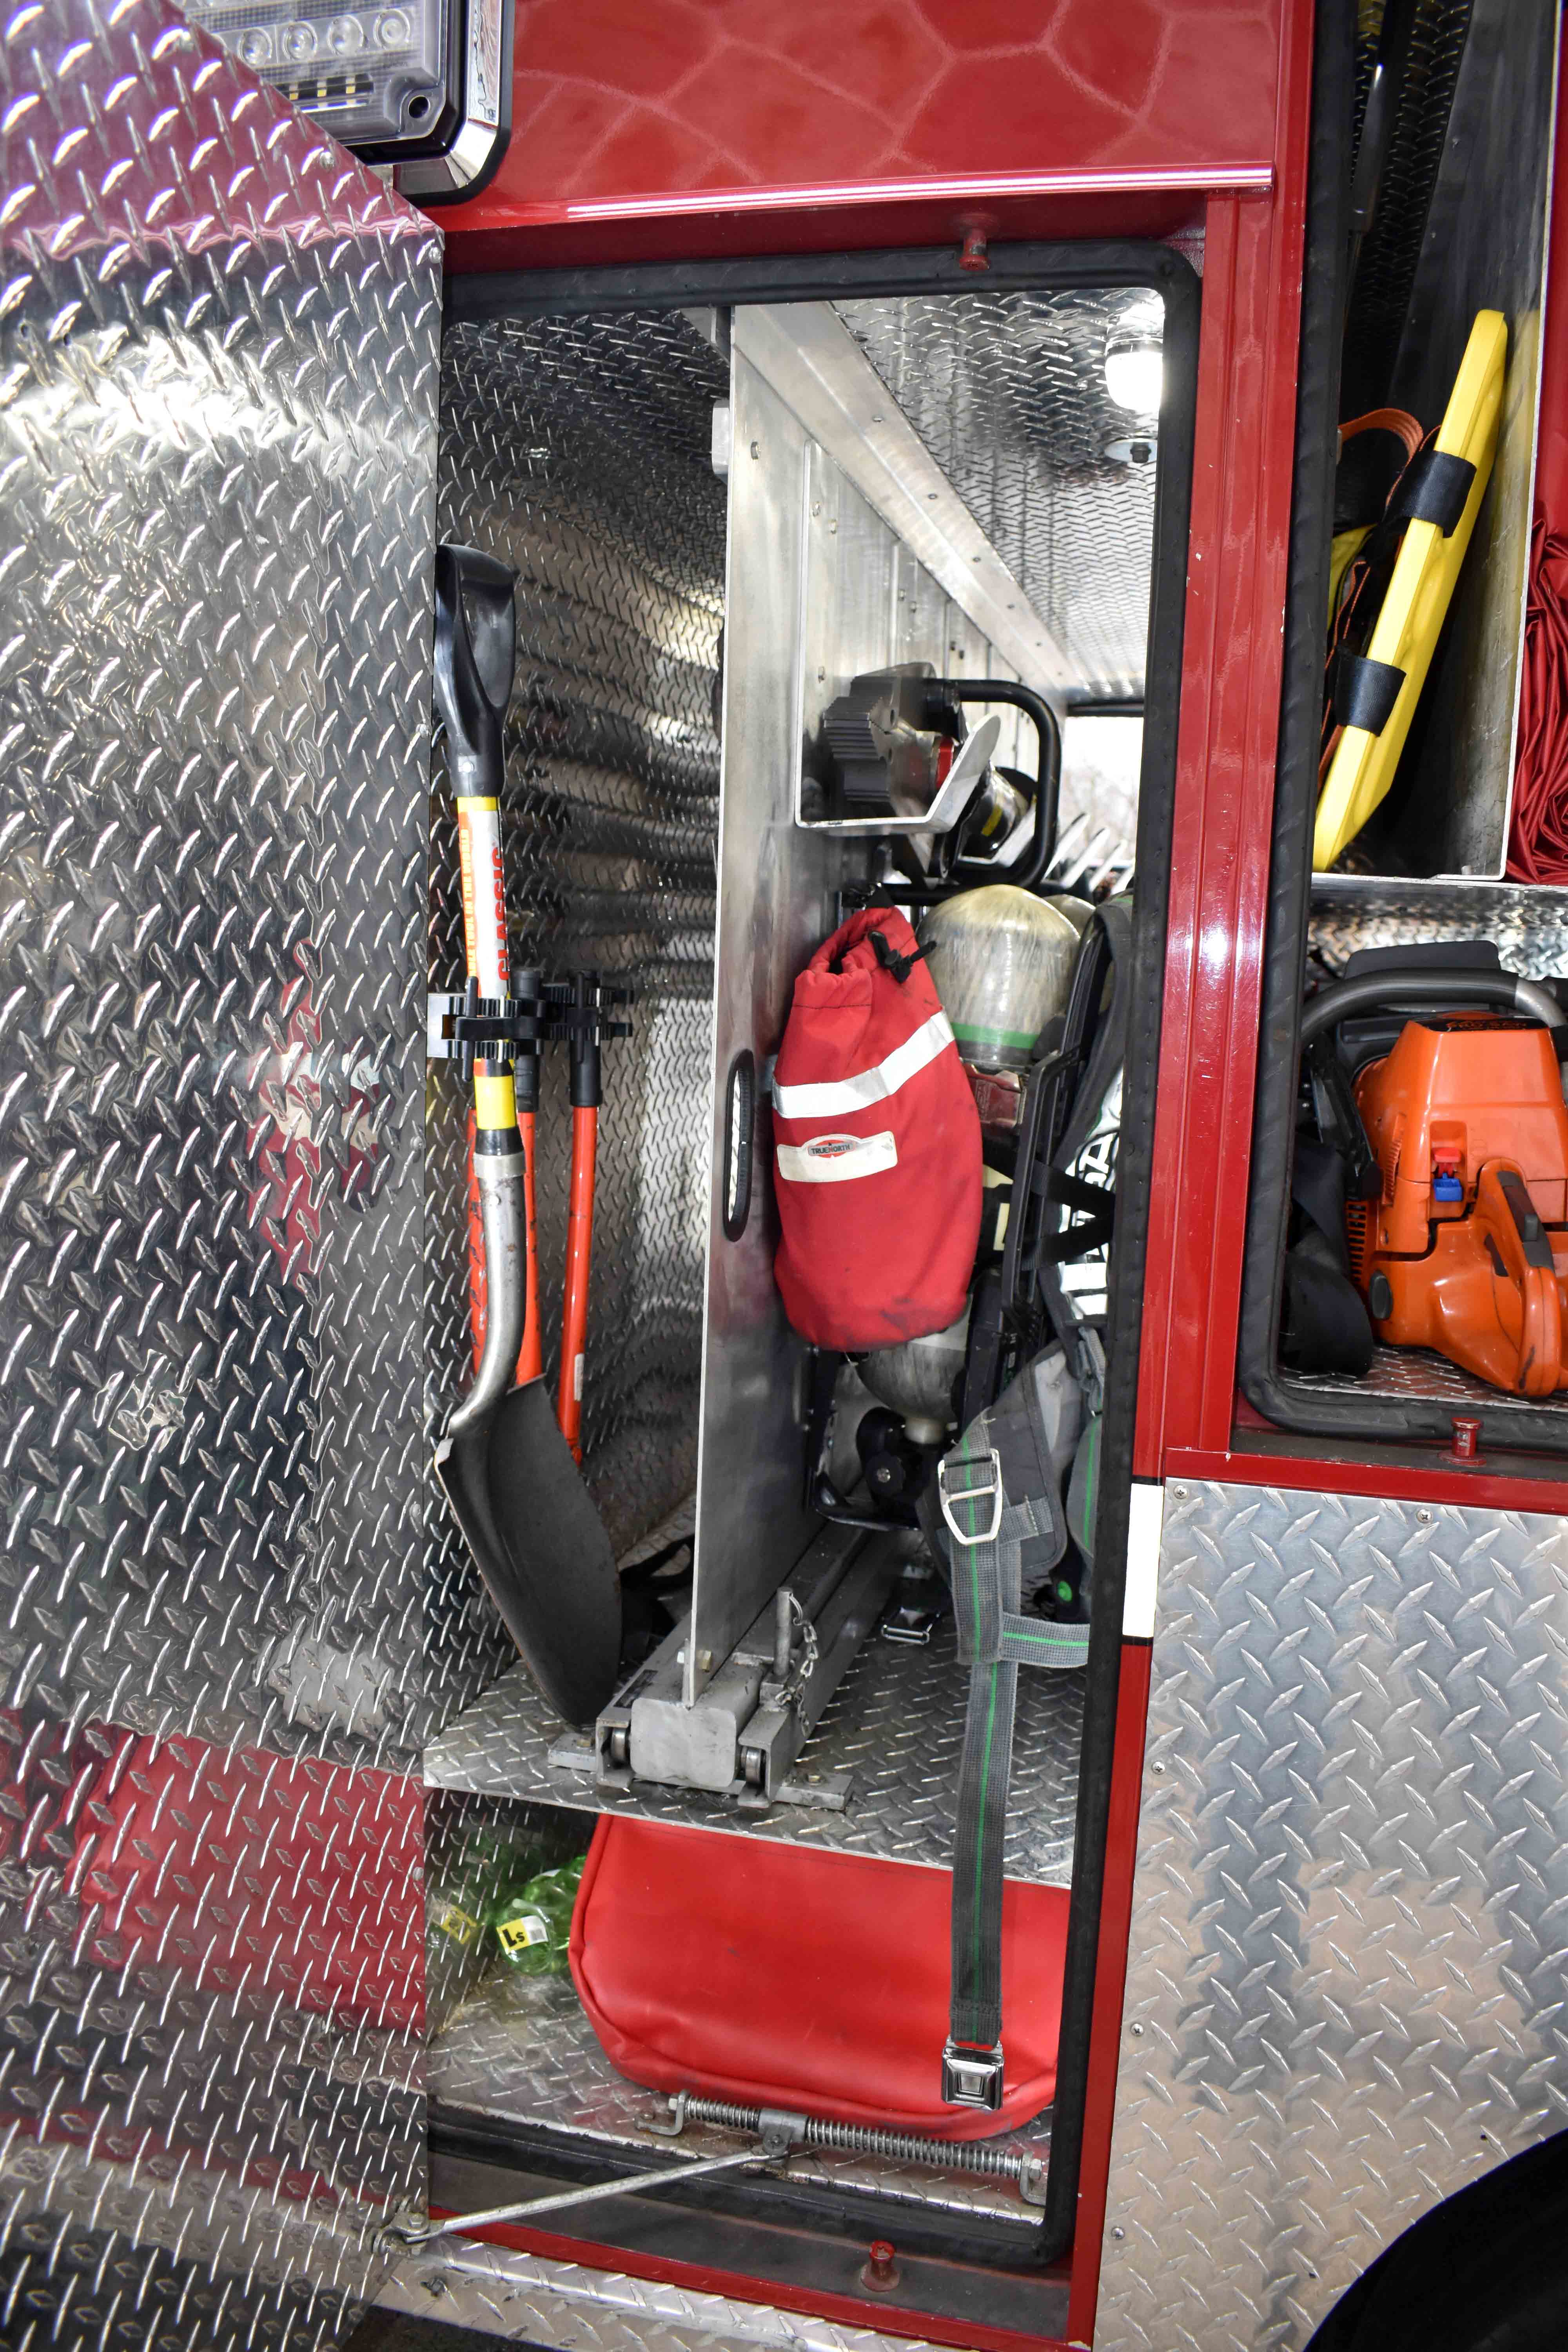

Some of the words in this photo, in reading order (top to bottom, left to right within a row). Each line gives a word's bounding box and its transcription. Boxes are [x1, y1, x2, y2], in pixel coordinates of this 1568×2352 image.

[460, 829, 472, 874] WORLD
[463, 875, 473, 899] THE
[464, 901, 474, 915] IN
[465, 915, 475, 947] TOOL
[467, 949, 477, 976] ABLE
